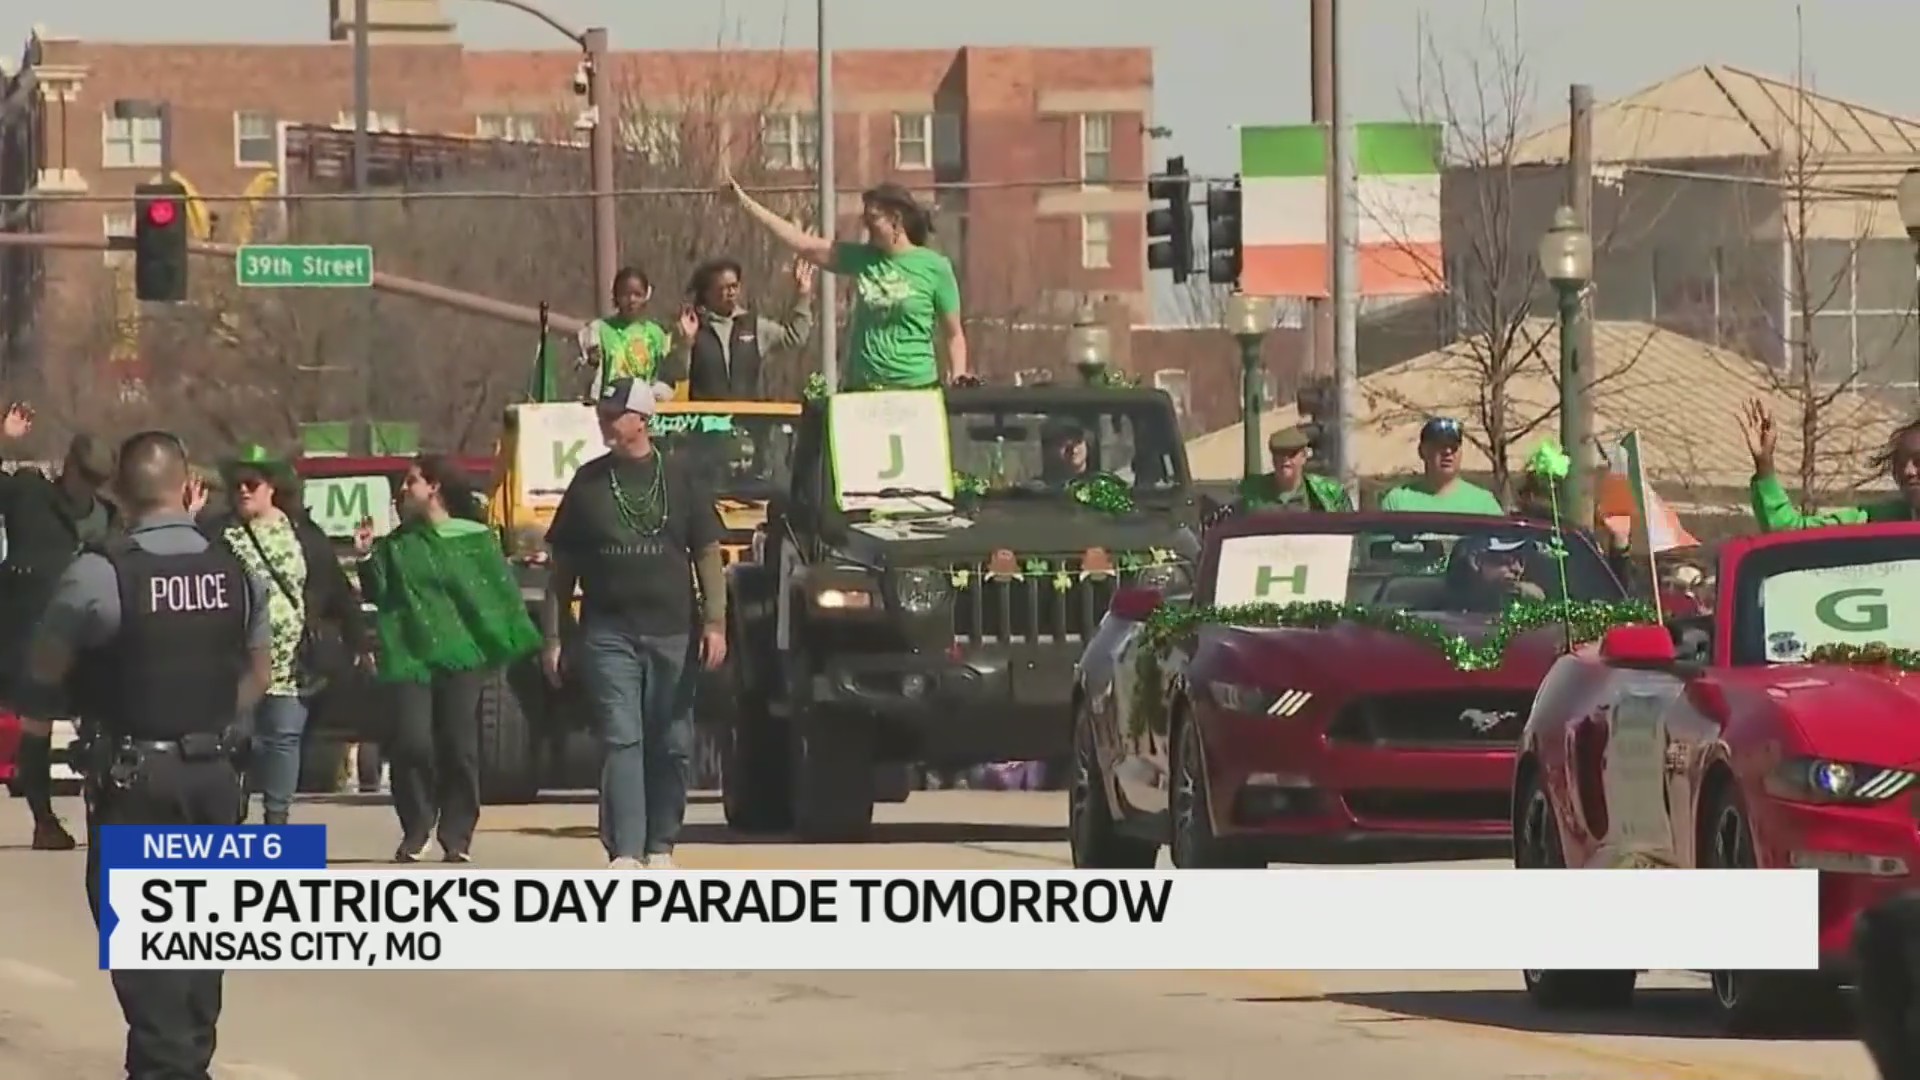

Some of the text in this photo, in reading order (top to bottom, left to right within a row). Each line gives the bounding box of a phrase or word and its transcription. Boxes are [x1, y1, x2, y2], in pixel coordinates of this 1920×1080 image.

[246, 255, 363, 277] 39th Street
[552, 439, 587, 479] K
[877, 433, 905, 480] J
[325, 482, 369, 518] M
[150, 573, 229, 613] POLICE
[1255, 564, 1308, 597] H
[1815, 587, 1889, 633] G
